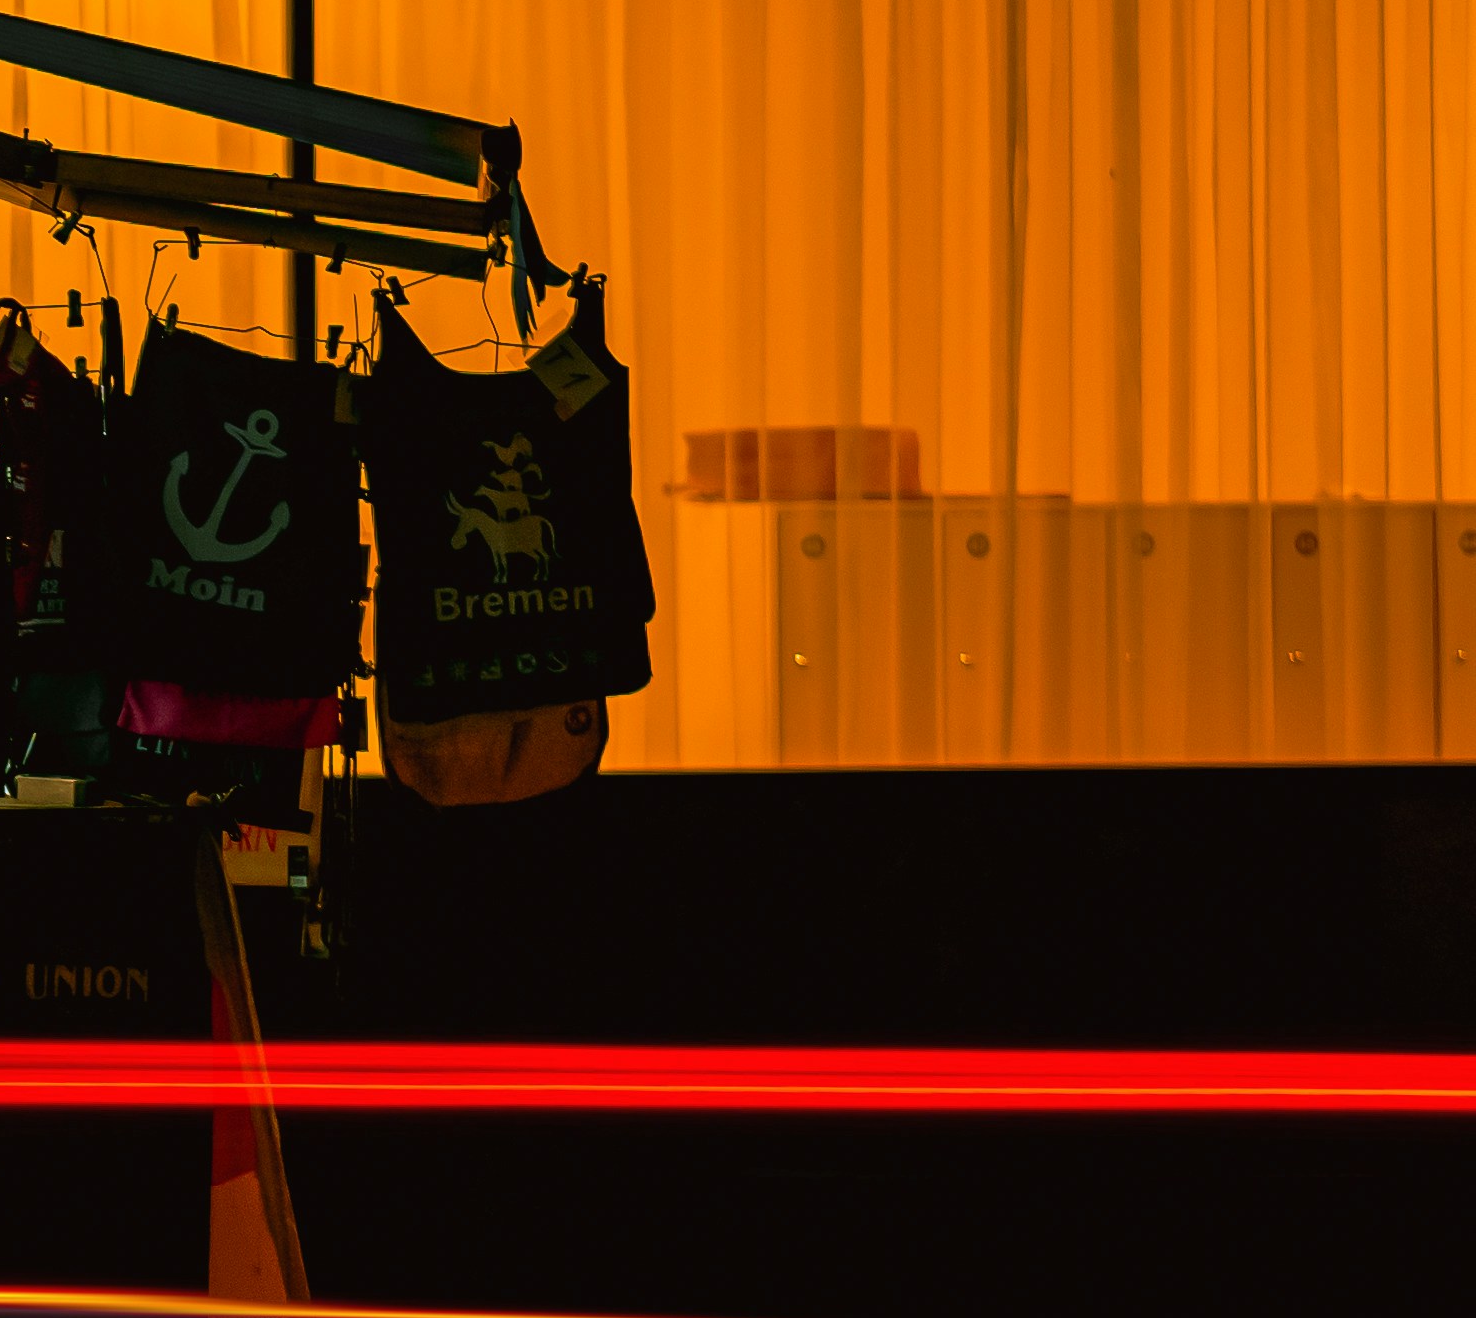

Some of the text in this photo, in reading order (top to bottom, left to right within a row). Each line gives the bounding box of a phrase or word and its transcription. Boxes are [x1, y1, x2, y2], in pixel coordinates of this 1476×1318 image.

[144, 557, 268, 614] Moin
[432, 583, 597, 624] Bremen
[24, 962, 150, 1002] UNION
